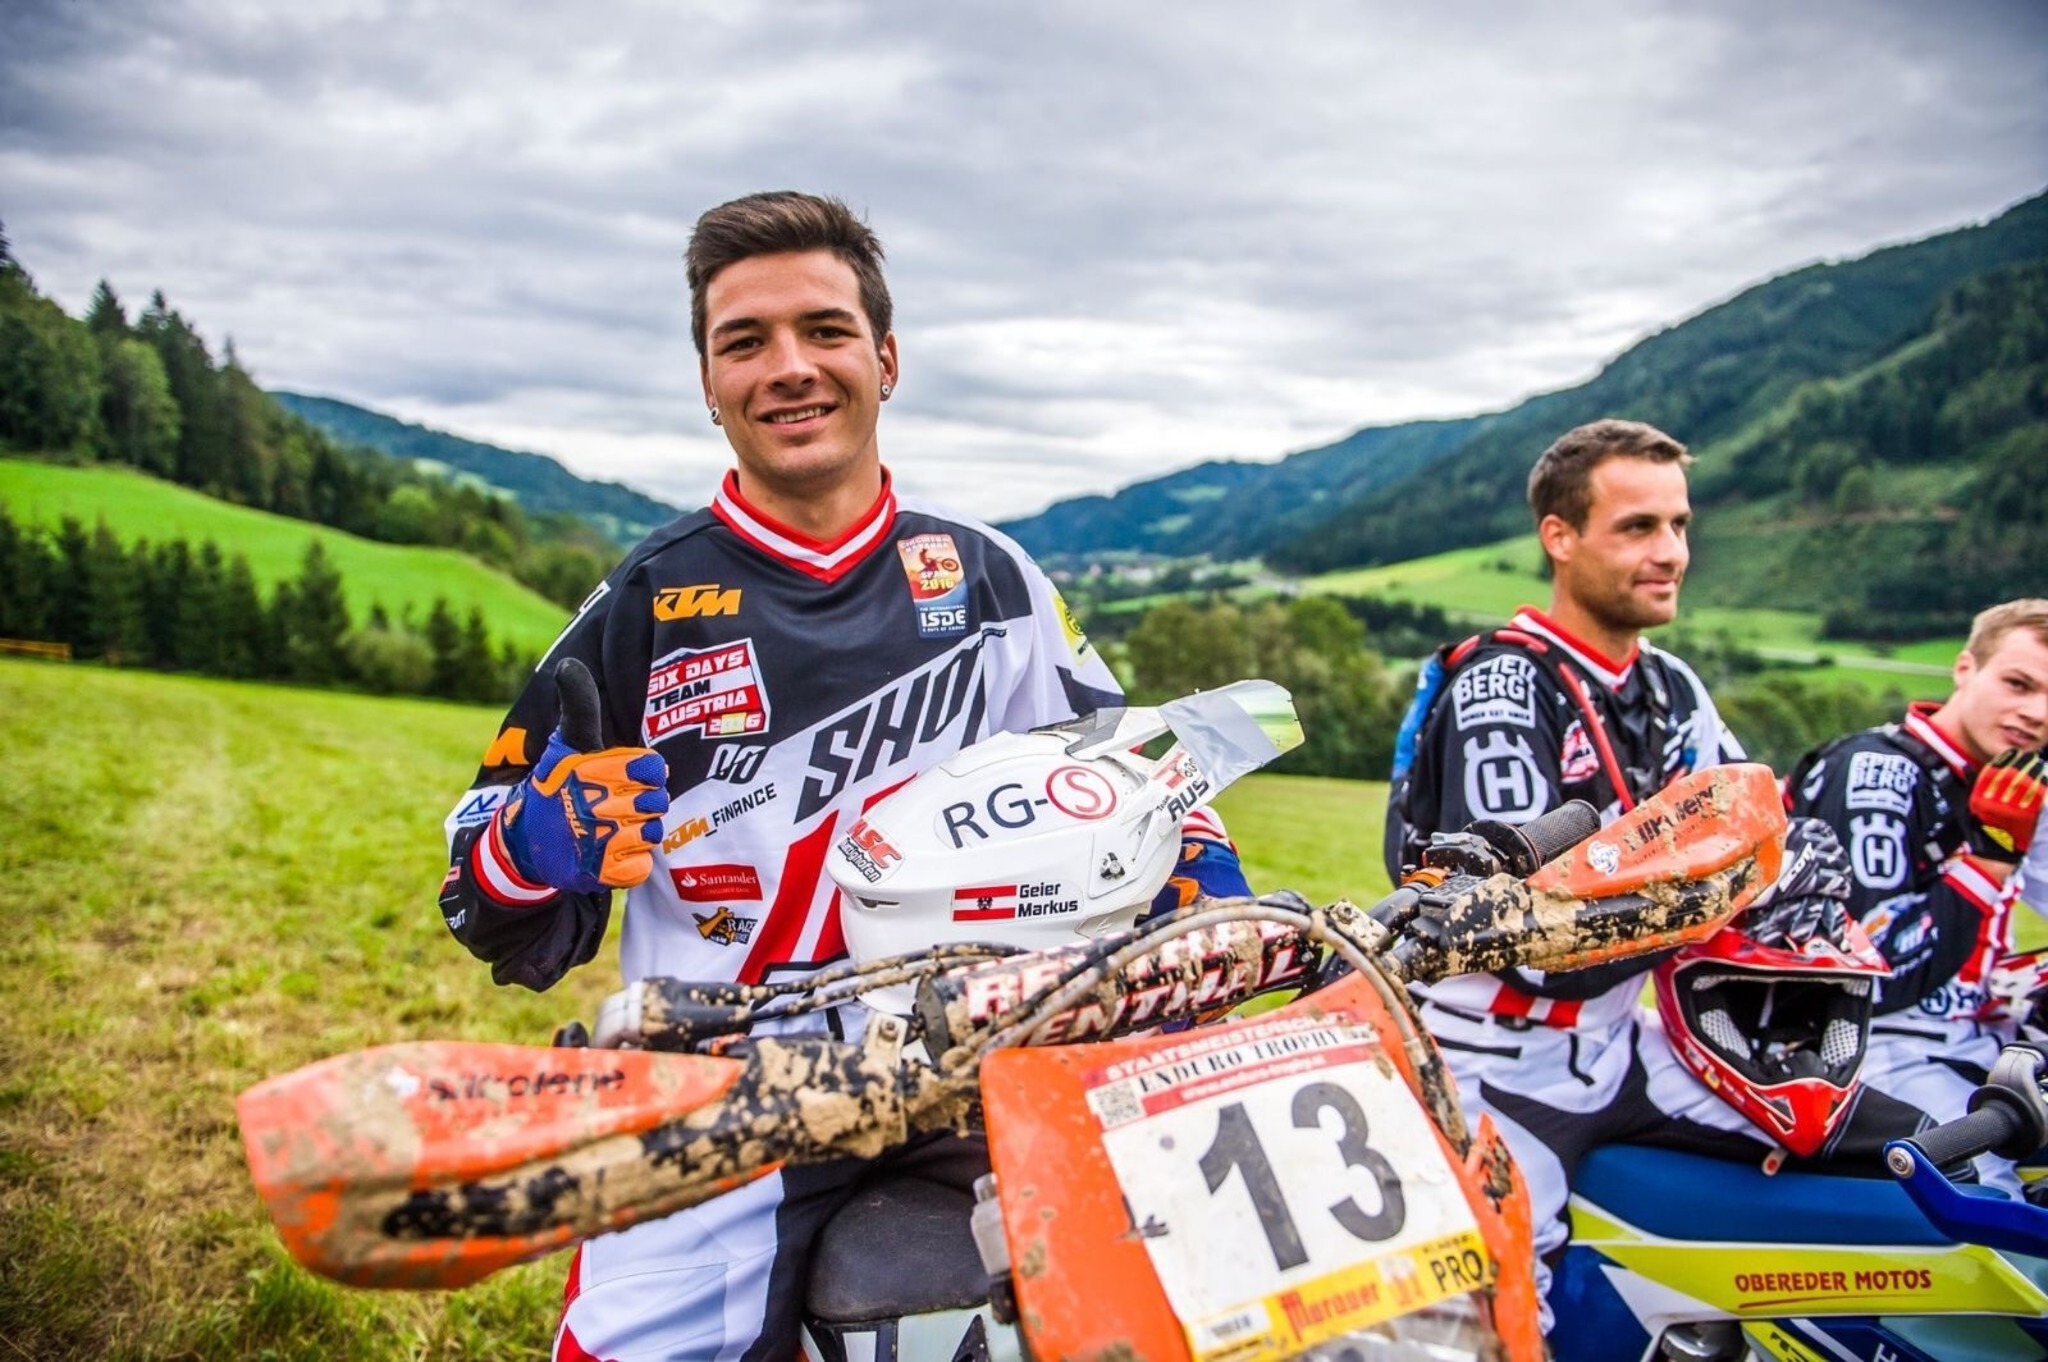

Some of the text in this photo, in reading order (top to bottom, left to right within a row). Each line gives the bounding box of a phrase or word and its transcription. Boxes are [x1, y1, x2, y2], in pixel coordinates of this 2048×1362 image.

[653, 584, 742, 621] KTM
[920, 609, 966, 628] ISDE
[648, 649, 744, 692] SIX DAYS
[650, 679, 711, 712] TEAM
[1460, 673, 1526, 704] BERG
[656, 689, 748, 732] AUSTRIA
[1167, 780, 1209, 822] AUS
[699, 871, 757, 887] Santander
[1019, 881, 1061, 899] Geier
[1017, 899, 1078, 918] Markus
[1139, 1028, 1341, 1093] ENDURO TROPHY
[1198, 1081, 1407, 1273] 13
[1430, 1248, 1484, 1293] PRO
[1734, 1270, 1932, 1293] OBEREDER MOTOS
